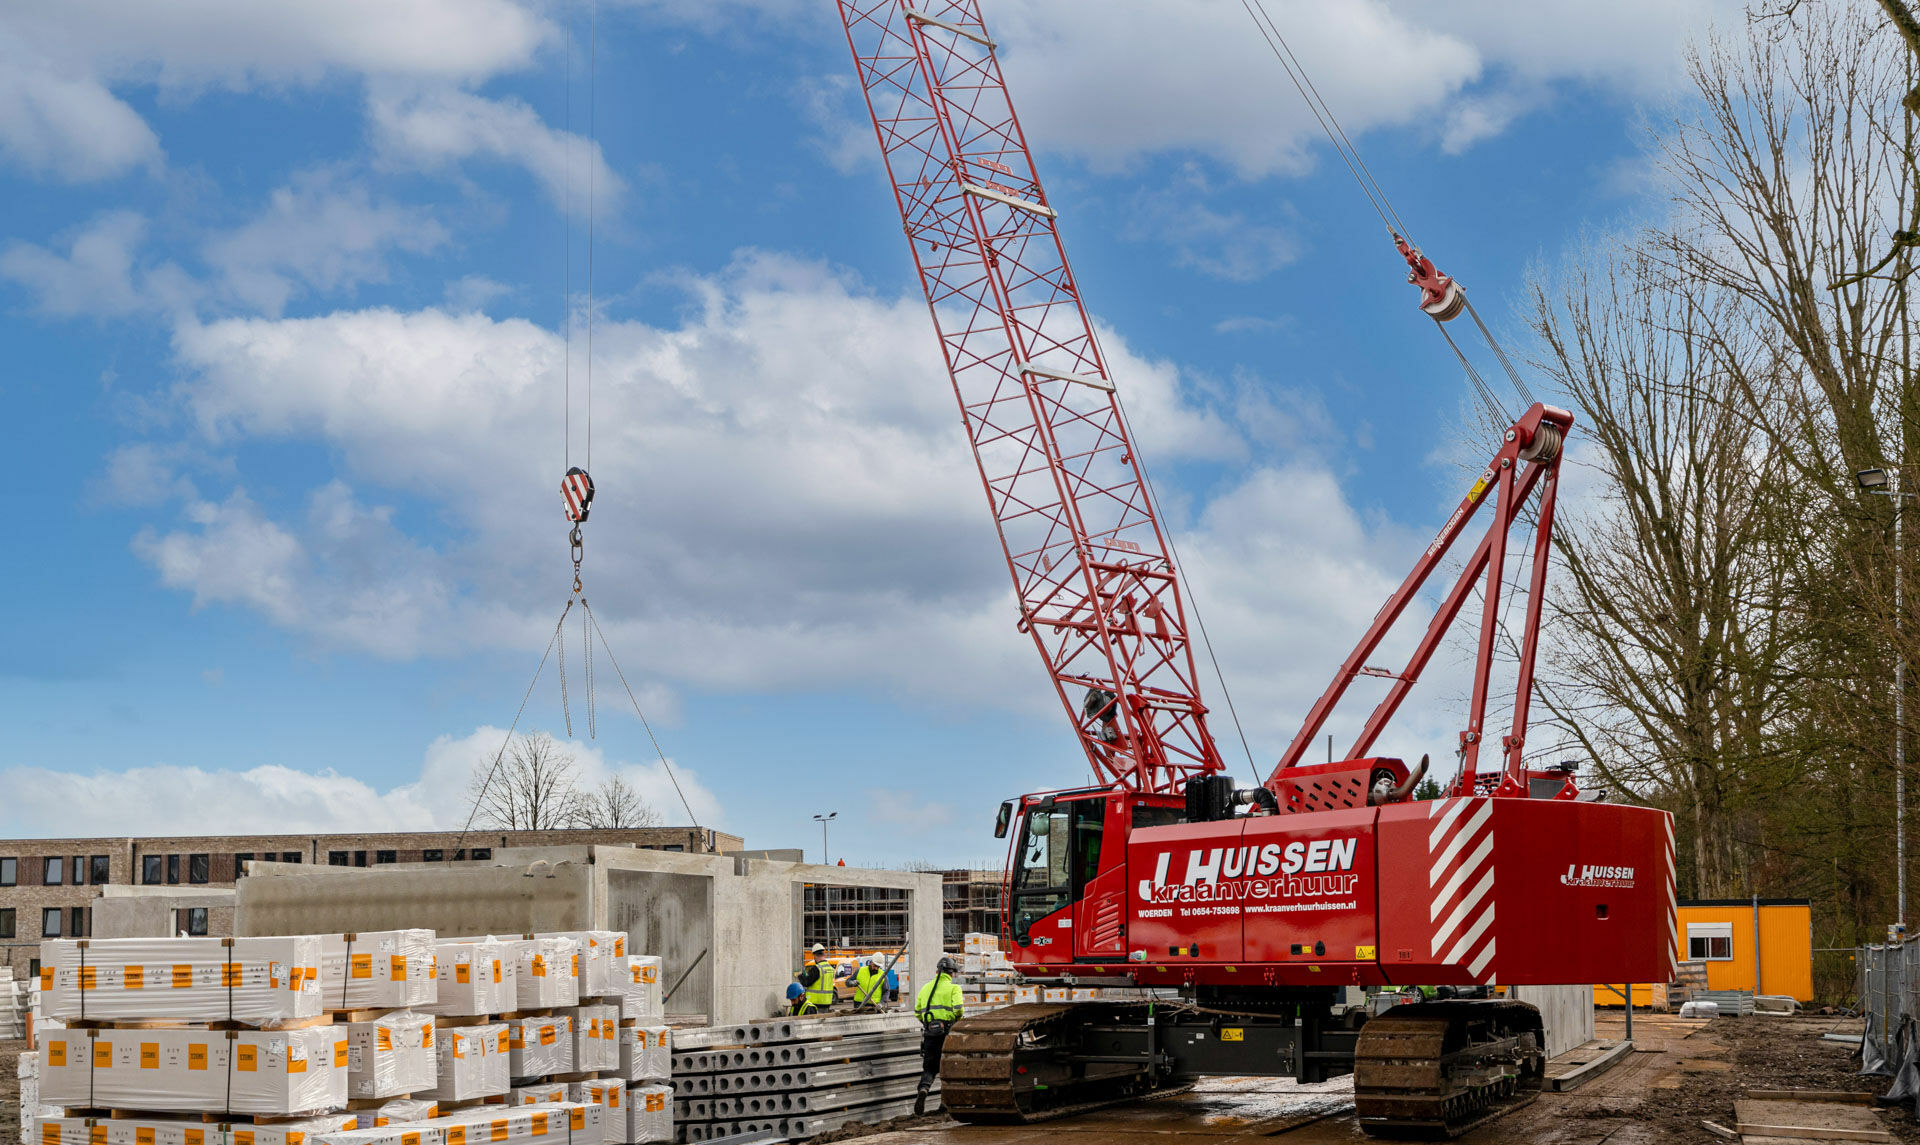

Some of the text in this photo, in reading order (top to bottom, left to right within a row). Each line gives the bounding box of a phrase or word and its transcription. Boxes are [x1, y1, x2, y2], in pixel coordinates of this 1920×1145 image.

[1138, 838, 1358, 901] J HUISSEN
[1560, 864, 1634, 884] J HUISSEN
[1150, 873, 1358, 904] kraanverhuur
[1138, 900, 1357, 919] WOERDEN Tel 0654-753698 www.kraanverhuurhuissen.nl
